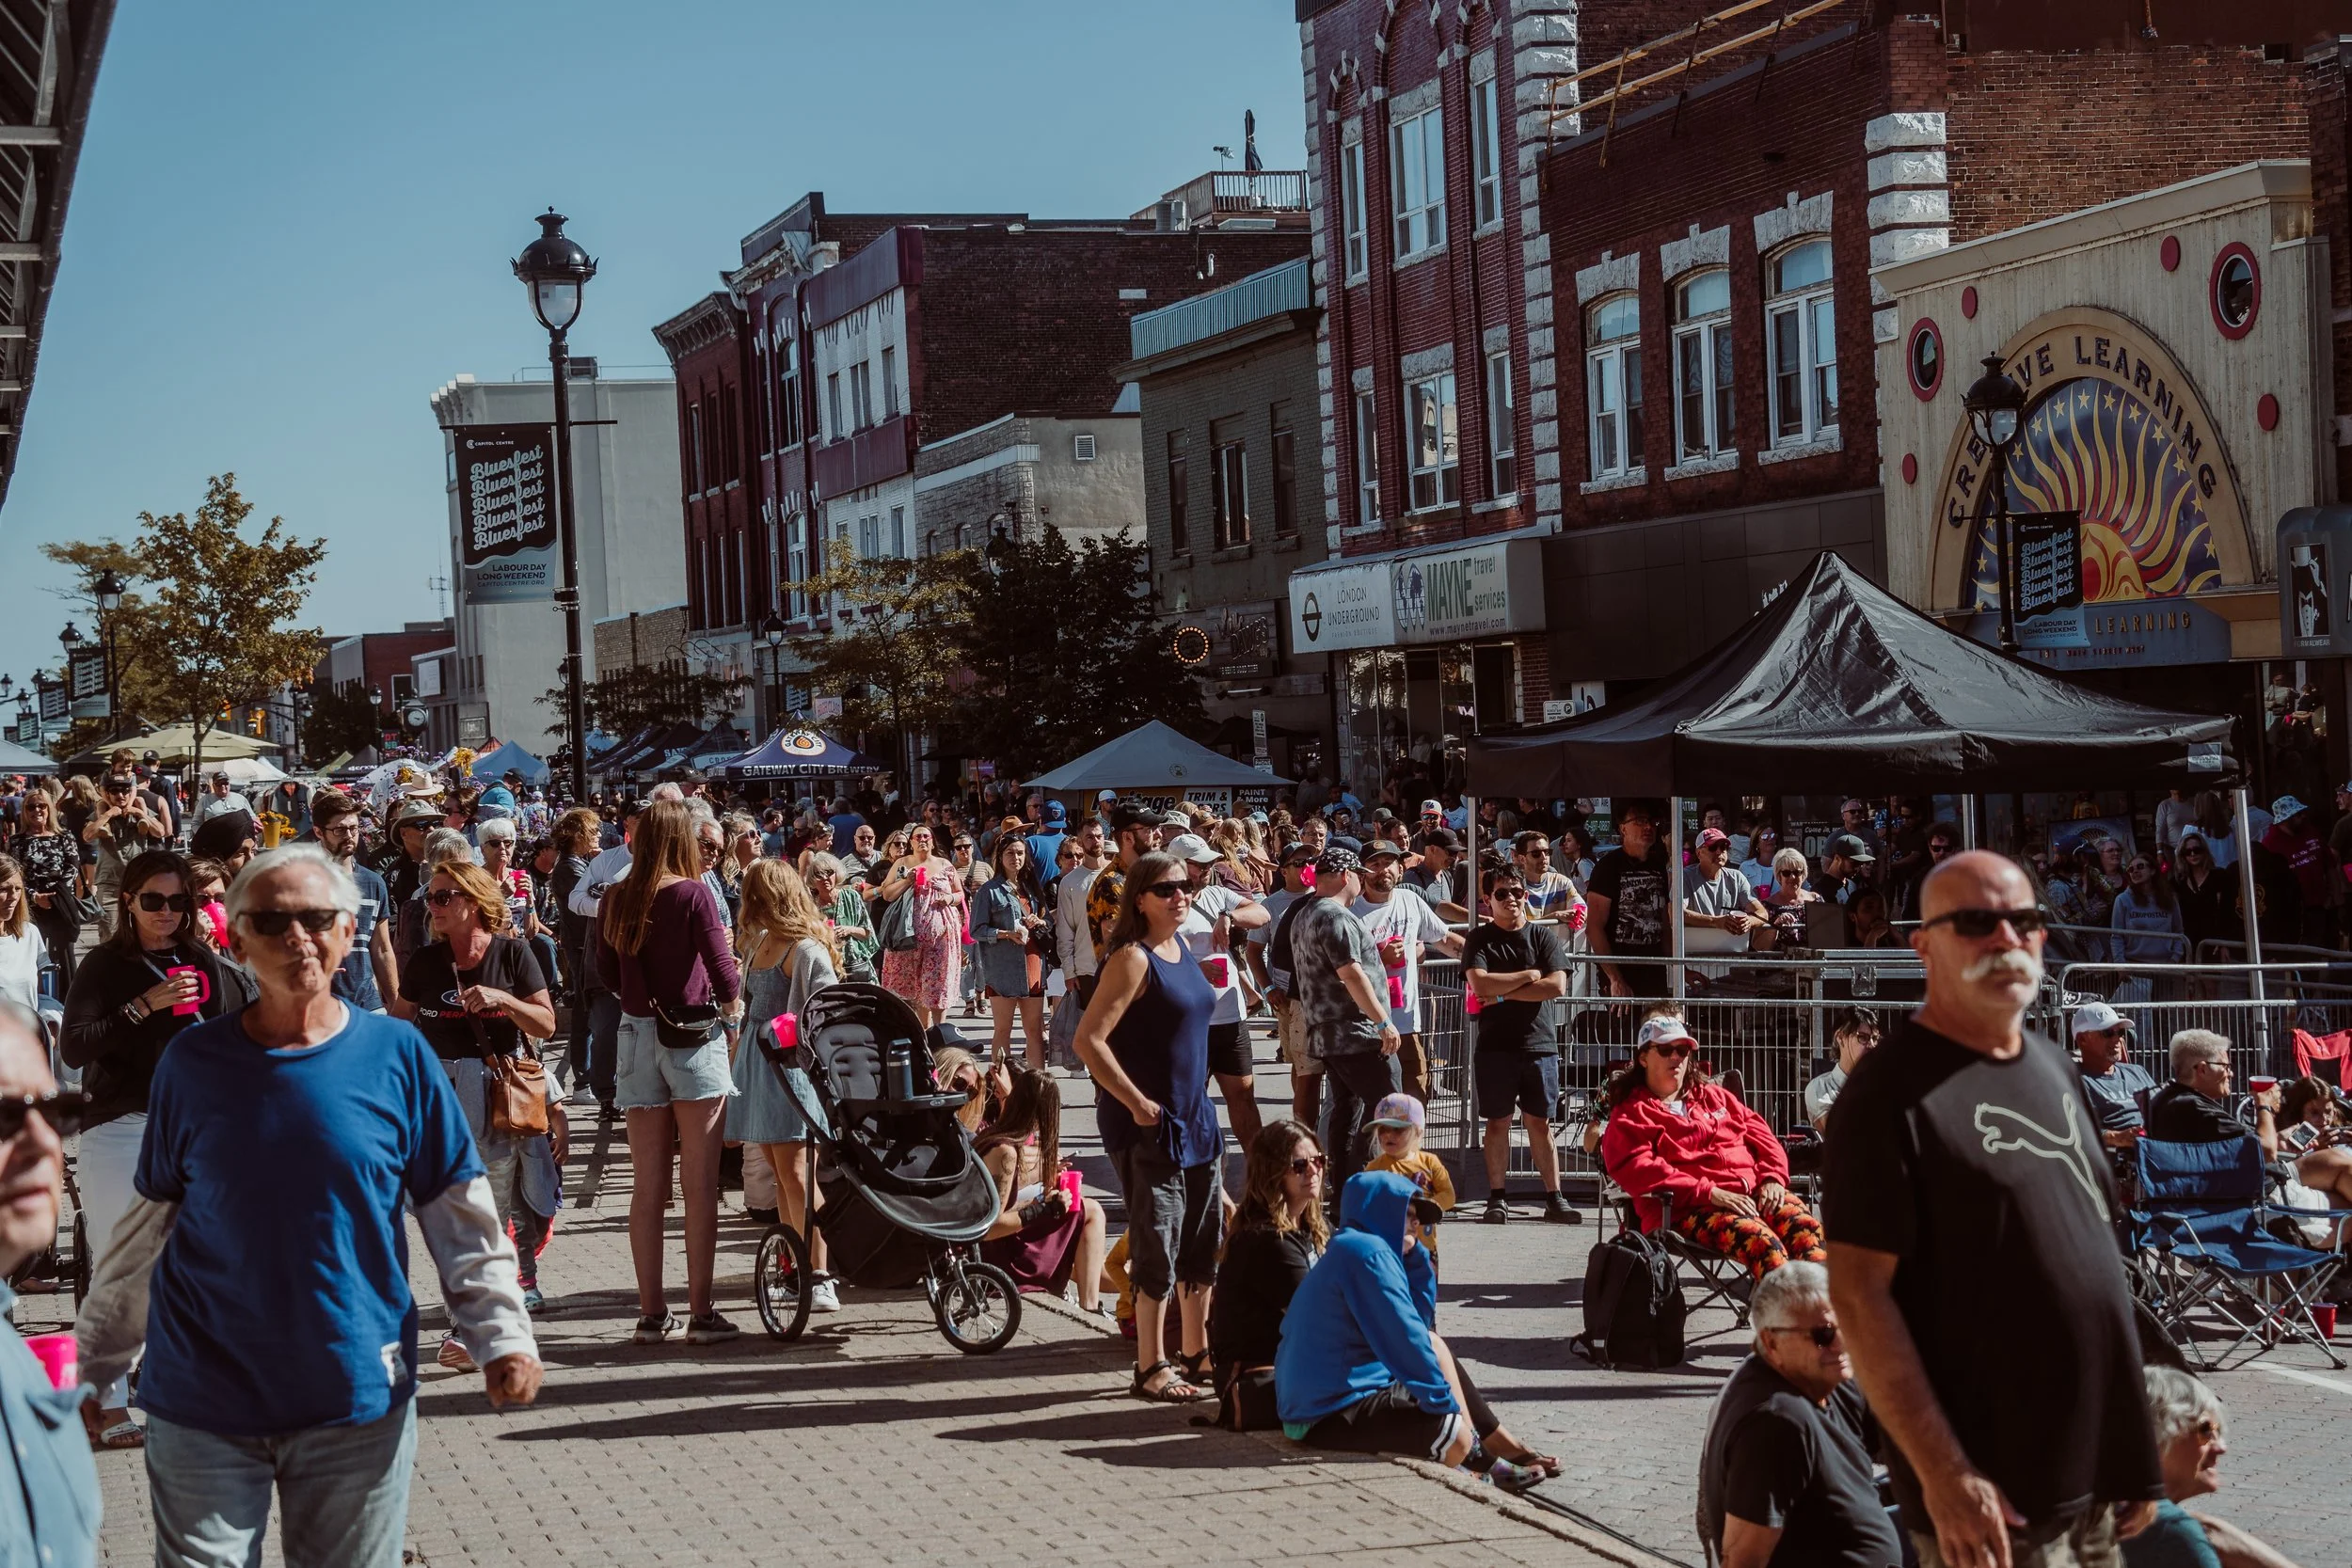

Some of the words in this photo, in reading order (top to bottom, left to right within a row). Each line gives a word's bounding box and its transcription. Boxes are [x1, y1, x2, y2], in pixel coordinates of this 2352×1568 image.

[1947, 342, 2055, 529] CREVE
[2074, 335, 2217, 499] LEARNING
[470, 444, 544, 482] Bluesfest
[471, 461, 545, 499] Bluesfest
[472, 479, 545, 516] Bluesfest
[473, 496, 546, 533] Bluesfest
[474, 513, 546, 551] Bluesfest
[2020, 527, 2074, 558] Bluesfest
[1473, 555, 1496, 577] travel
[2020, 541, 2074, 571] Bluesfest
[503, 571, 546, 579] WEEKEND
[2021, 554, 2074, 584] Bluesfest
[477, 579, 546, 588] CAPITOLCENTRE.ORG
[1426, 559, 1473, 622] MAYNE
[2021, 568, 2074, 597] Bluesfest
[1337, 587, 1367, 605] LONDON
[1474, 587, 1505, 611] services
[2020, 581, 2074, 612] Bluesfest
[1327, 606, 1380, 626] UNDERGROUND
[1429, 617, 1505, 637] www.maynetravel.com
[2094, 610, 2191, 635] LEARNING
[2294, 639, 2330, 647] FORMALWEAR
[810, 733, 823, 749] CITY
[742, 764, 797, 777] GATEWAY
[799, 763, 825, 775] CITY
[827, 764, 880, 775] BREWERY
[1091, 790, 1177, 816] ritage
[1187, 792, 1217, 801] TRIM
[1217, 791, 1228, 801] &
[1239, 788, 1266, 797] PAINT
[420, 1006, 438, 1018] FORD
